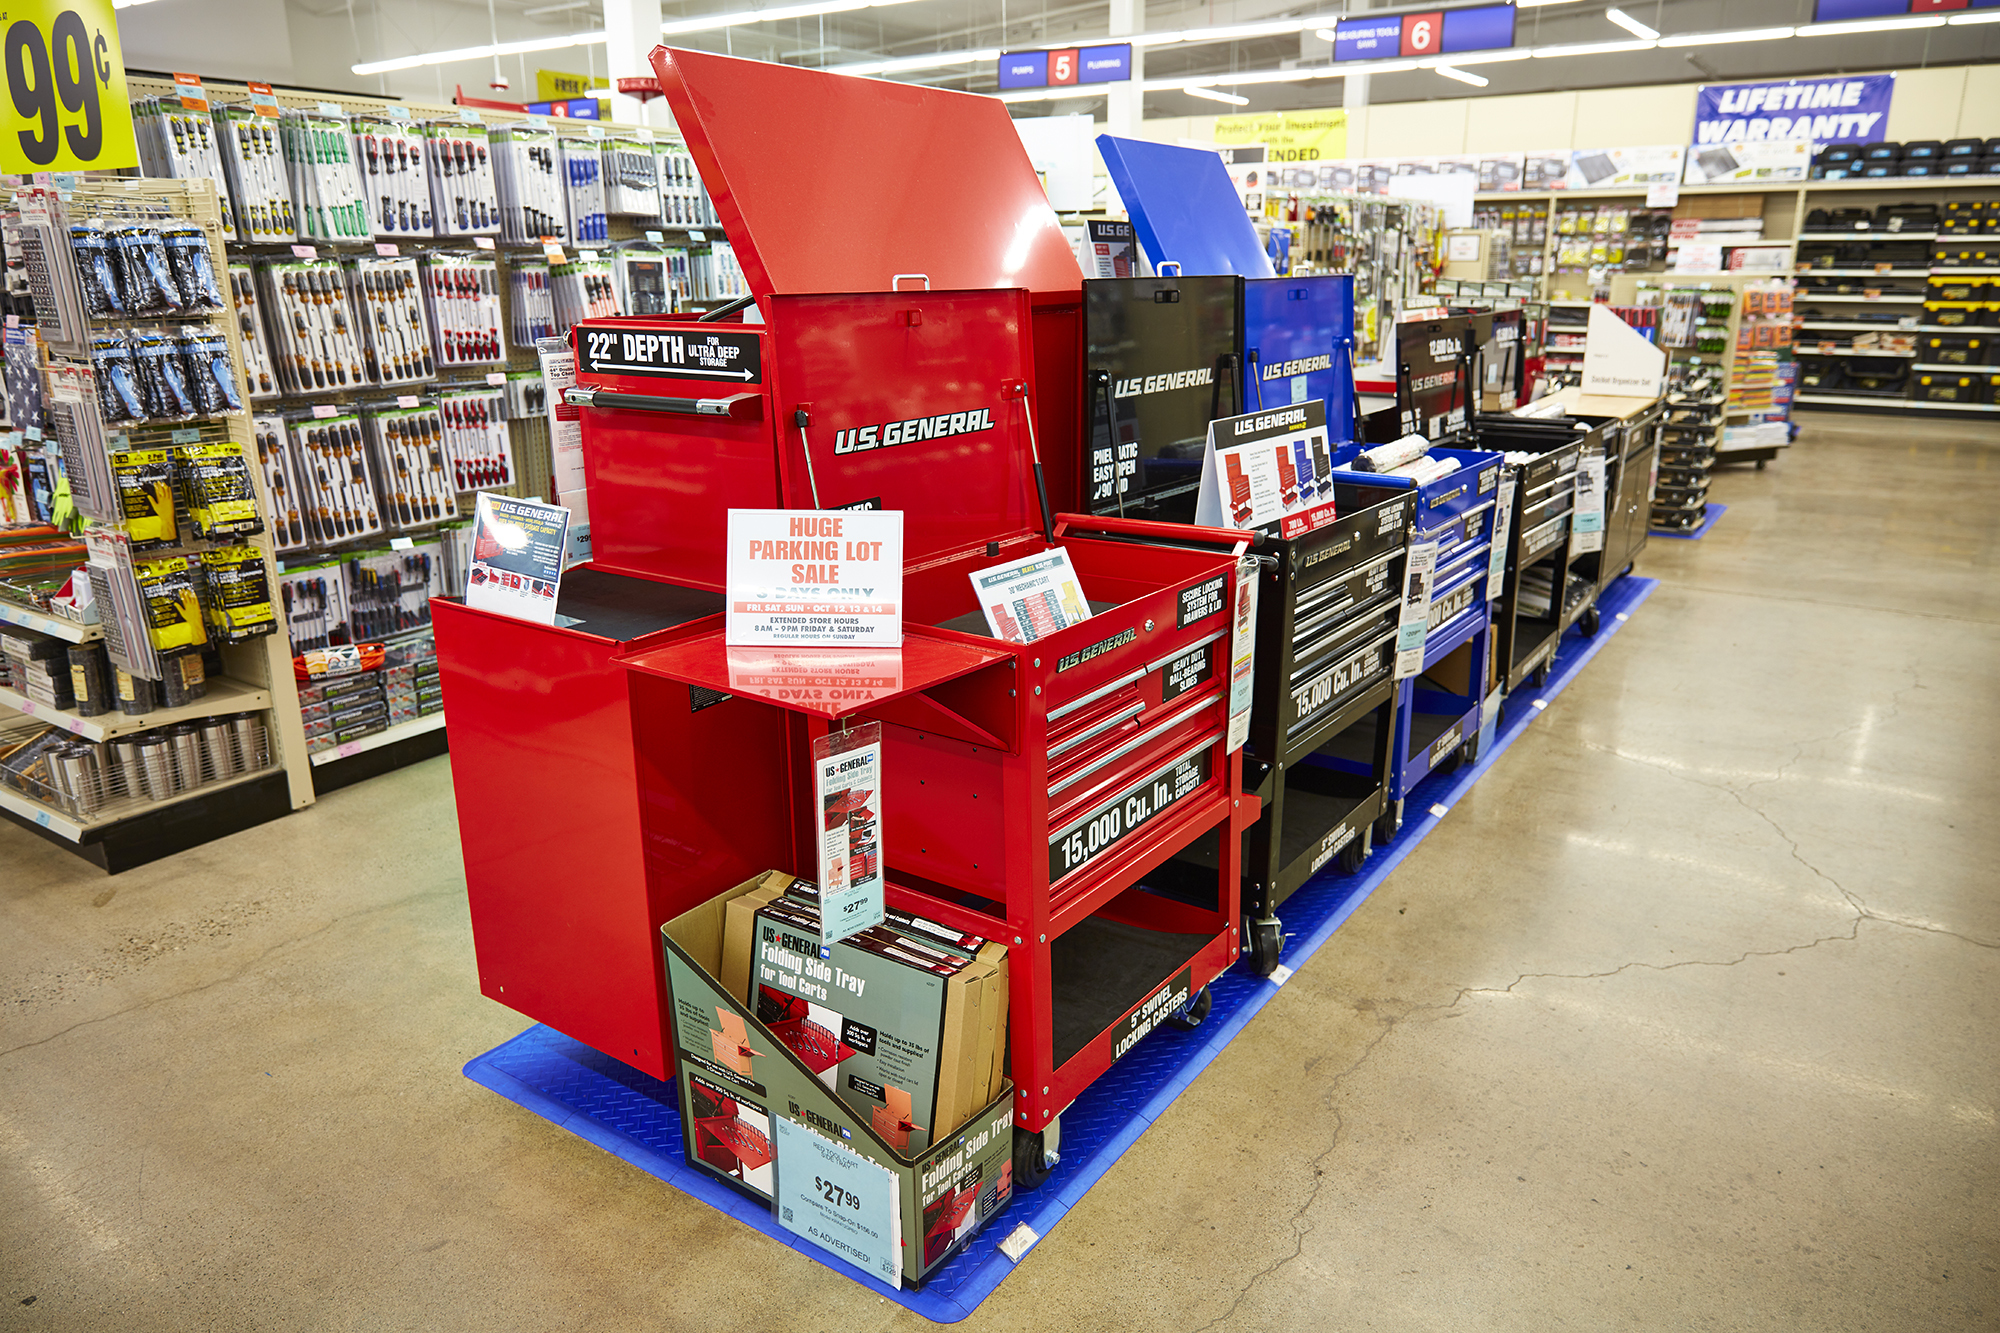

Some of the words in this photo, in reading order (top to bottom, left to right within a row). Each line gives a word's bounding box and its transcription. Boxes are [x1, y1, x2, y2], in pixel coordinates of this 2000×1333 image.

[1336, 28, 1375, 41] MEASURING
[1376, 26, 1399, 37] TOOLS
[1411, 20, 1431, 50] 6
[1357, 39, 1377, 49] SAWS
[1012, 65, 1034, 75] PUMPS
[1055, 56, 1071, 80] 5
[1087, 59, 1121, 70] PLUMBING
[1718, 81, 1865, 114] LIFETIME
[1698, 112, 1883, 144] WARRANTY
[587, 332, 618, 360] 22"
[622, 333, 685, 364] DEPTH
[688, 344, 714, 358] ULTRA
[717, 346, 740, 359] DEEP
[706, 336, 719, 346] FOR
[699, 357, 727, 367] STORAGE
[1282, 353, 1332, 377] GENERAL
[1143, 367, 1214, 394] GENERAL
[882, 408, 996, 447] GENERAL
[1255, 408, 1308, 431] GENERAL
[1094, 464, 1115, 483] EASY
[516, 505, 564, 524] GENERAL
[789, 517, 843, 537] HUGE
[749, 540, 839, 561] PARKING
[846, 541, 883, 561] LOT
[791, 564, 839, 584] SALE
[756, 587, 769, 599] 3
[775, 587, 821, 599] DAYS
[826, 587, 875, 600] ONLY
[1182, 588, 1202, 604] SECURE
[1203, 577, 1223, 594] LOCKING
[1186, 596, 1207, 612] SYSTEM
[1207, 591, 1219, 602] FOR
[785, 604, 804, 612] SUN
[813, 604, 831, 613] OCT
[850, 605, 861, 613] 13
[871, 605, 883, 613] 14
[1184, 608, 1208, 625] DRAWERS
[1213, 599, 1222, 611] LID
[1080, 627, 1138, 664] GENERAL
[1172, 655, 1190, 673] HEAVY
[1190, 648, 1205, 664] DUTY
[1169, 659, 1207, 687] BALL-BEARING
[1179, 674, 1198, 692] SLIDES
[1296, 676, 1332, 718] 15,000
[1333, 670, 1350, 695] Cu.
[1350, 661, 1363, 684] In.
[825, 766, 836, 777] US
[840, 755, 869, 774] GENERAL
[826, 773, 846, 787] Folding
[847, 769, 859, 780] Side
[860, 764, 873, 778] Tray
[1175, 760, 1191, 776] TOTAL
[1175, 765, 1198, 788] STORAGE
[1175, 775, 1201, 799] CAPACITY
[1062, 807, 1121, 869] 15,000
[1125, 796, 1151, 829] Cu.
[1153, 781, 1173, 811] In.
[1328, 822, 1347, 845] SWIVEL
[1311, 845, 1333, 874] LOCKING
[1333, 826, 1356, 854] CASTERS
[763, 925, 776, 944] US
[781, 932, 822, 960] GENERAL
[761, 941, 803, 975] Folding
[805, 957, 832, 983] Side
[835, 967, 866, 998] Tray
[760, 963, 776, 981] for
[778, 969, 797, 990] Tool
[798, 977, 828, 1002] Carts
[678, 998, 692, 1008] Holds
[692, 1004, 698, 1012] up
[1141, 984, 1172, 1020] SWIVEL
[680, 1011, 690, 1019] and
[699, 1014, 710, 1022] tools
[1115, 1017, 1152, 1059] LOCKING
[1152, 986, 1188, 1027] CASTERS
[849, 1024, 860, 1032] Adds
[848, 1036, 869, 1049] workspace
[879, 1038, 891, 1046] tools
[891, 1041, 901, 1050] and
[901, 1045, 924, 1058] supplies!
[880, 1031, 894, 1040] Holds
[894, 1036, 901, 1044] up
[915, 1043, 923, 1051] lbs
[690, 1053, 707, 1064] Designed
[733, 1072, 748, 1083] General
[695, 1076, 706, 1085] Adds
[741, 1098, 763, 1113] workspace
[788, 1100, 800, 1117] US
[806, 1109, 846, 1140] GENERAL
[812, 1142, 825, 1152] RED
[825, 1148, 842, 1161] TOOL
[842, 1156, 859, 1169] CART
[820, 1153, 834, 1163] SIDE
[837, 1159, 852, 1171] TRAY
[921, 1149, 963, 1194] Folding
[965, 1130, 989, 1160] Side
[991, 1107, 1014, 1139] Tray
[921, 1161, 931, 1174] US
[922, 1190, 935, 1207] for
[937, 1176, 951, 1196] Tool
[952, 1161, 973, 1184] Carts
[800, 1193, 824, 1211] Compare
[824, 1206, 833, 1215] To
[832, 1210, 856, 1227] Snap-On
[807, 1225, 819, 1237] AS
[819, 1232, 871, 1264] ADVERTISED!
